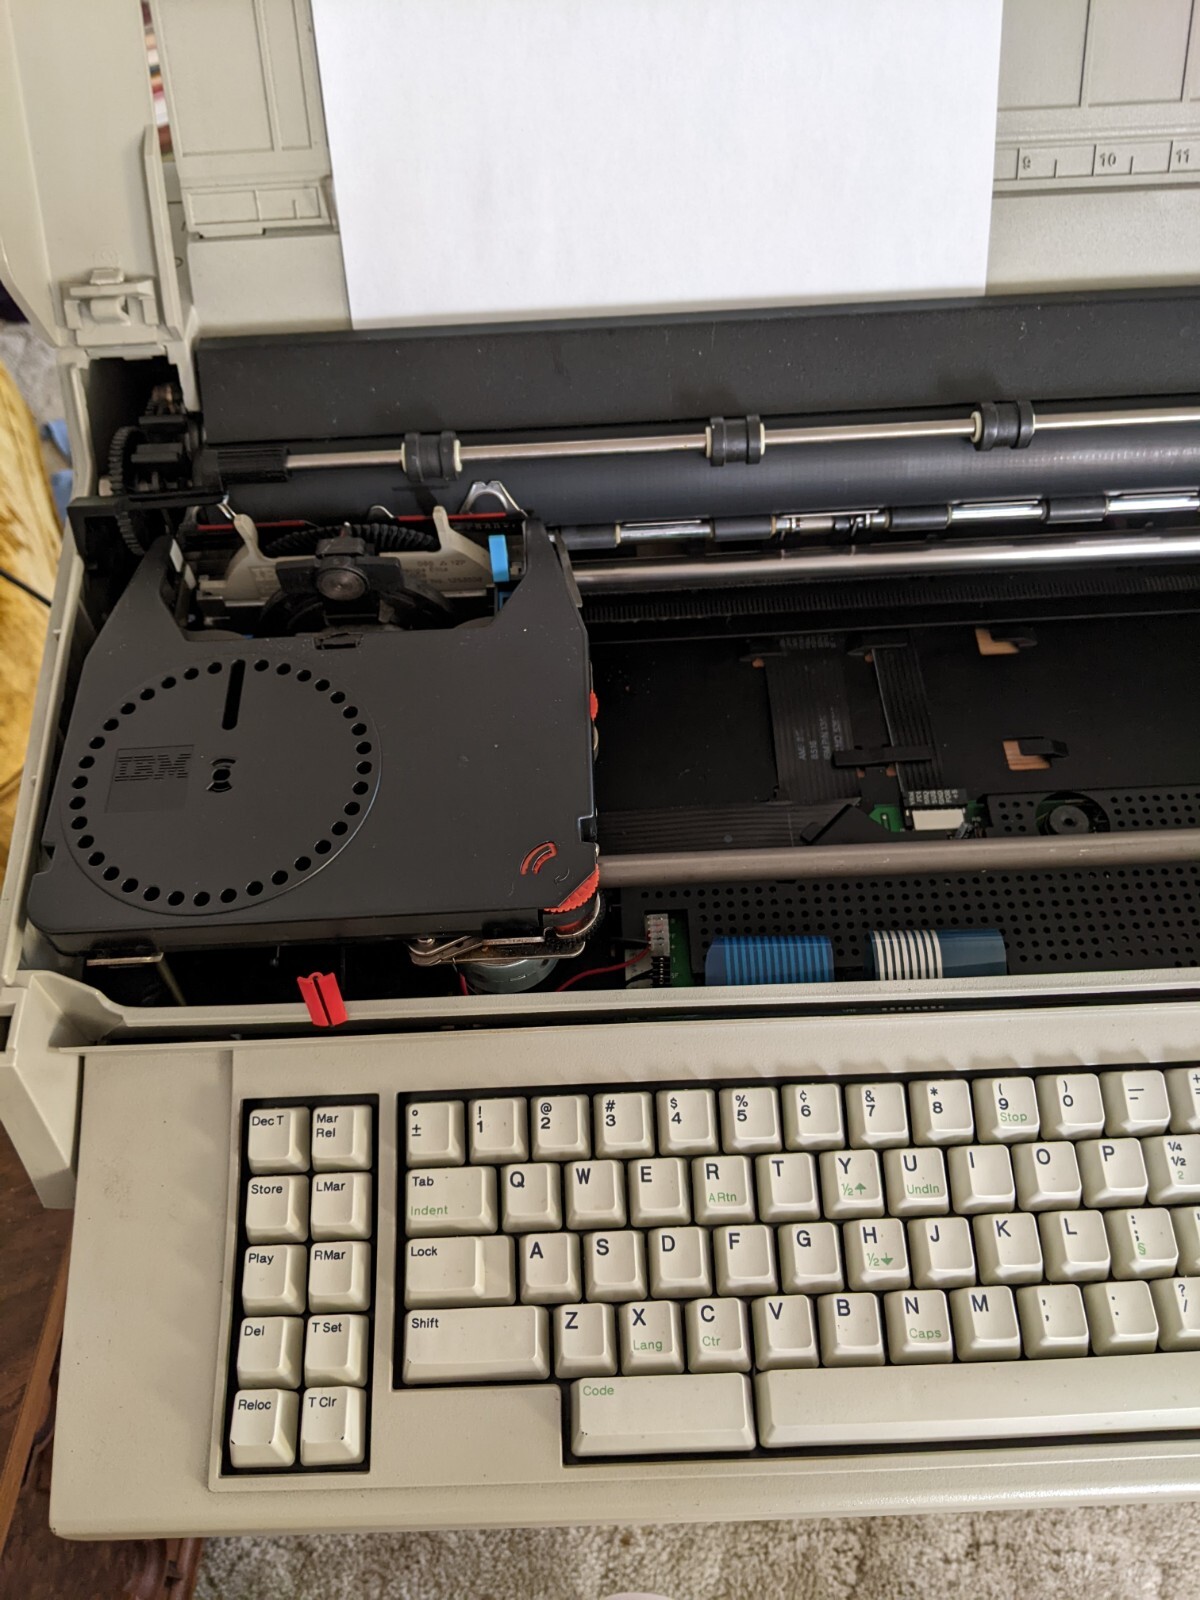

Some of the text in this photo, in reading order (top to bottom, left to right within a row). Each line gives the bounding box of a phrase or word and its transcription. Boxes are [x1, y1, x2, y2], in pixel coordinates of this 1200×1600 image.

[1100, 152, 1117, 167] 10
[1176, 149, 1190, 164] 11
[114, 753, 192, 782] IBM
[735, 1095, 749, 1107] %
[865, 1090, 875, 1103] &
[540, 1102, 552, 1115] @
[605, 1100, 616, 1112] #
[670, 1097, 678, 1110] $
[932, 1101, 943, 1114] 8
[998, 1098, 1009, 1110] 9
[478, 1106, 482, 1118] !
[737, 1109, 748, 1122] 5
[801, 1104, 811, 1117] 6
[865, 1104, 876, 1117] 7
[252, 1115, 284, 1126] Dec T
[316, 1113, 338, 1124] Mar
[540, 1117, 551, 1129] 2
[605, 1114, 616, 1127] 3
[671, 1112, 682, 1124] 4
[1000, 1112, 1028, 1123] Stop
[316, 1128, 336, 1138] Rel
[476, 1120, 484, 1133] 1
[969, 1151, 975, 1168] I
[1036, 1148, 1051, 1165] O
[1102, 1145, 1115, 1162] P
[772, 1160, 785, 1177] T
[838, 1157, 851, 1174] Y
[903, 1155, 917, 1172] U
[575, 1168, 591, 1184] W
[640, 1166, 652, 1183] E
[705, 1163, 720, 1180] R
[412, 1176, 434, 1187] Tab
[509, 1171, 525, 1188] Q
[251, 1184, 283, 1195] Store
[410, 1205, 448, 1216] Indent
[995, 1220, 1011, 1237] K
[1064, 1218, 1077, 1235] L
[796, 1230, 812, 1247] G
[862, 1226, 878, 1244] H
[930, 1225, 940, 1242] J
[596, 1238, 610, 1255] S
[661, 1235, 676, 1252] D
[728, 1232, 741, 1250] F
[410, 1246, 438, 1257] Lock
[529, 1241, 544, 1259] A
[248, 1253, 274, 1266] Play
[1178, 1284, 1186, 1297] ?
[836, 1298, 851, 1317] B
[905, 1297, 920, 1315] N
[971, 1294, 989, 1312] M
[1183, 1299, 1188, 1313] /
[632, 1308, 647, 1326] X
[700, 1305, 715, 1323] C
[768, 1302, 783, 1320] V
[312, 1322, 342, 1333] T Set
[411, 1318, 439, 1329] Shift
[564, 1312, 579, 1330] Z
[244, 1326, 264, 1337] Del
[909, 1328, 942, 1340] Caps
[633, 1340, 662, 1352] Lang
[702, 1336, 721, 1347] Ctr
[583, 1386, 615, 1396] Code
[238, 1399, 271, 1410] Reloc
[309, 1397, 337, 1408] T Clr
